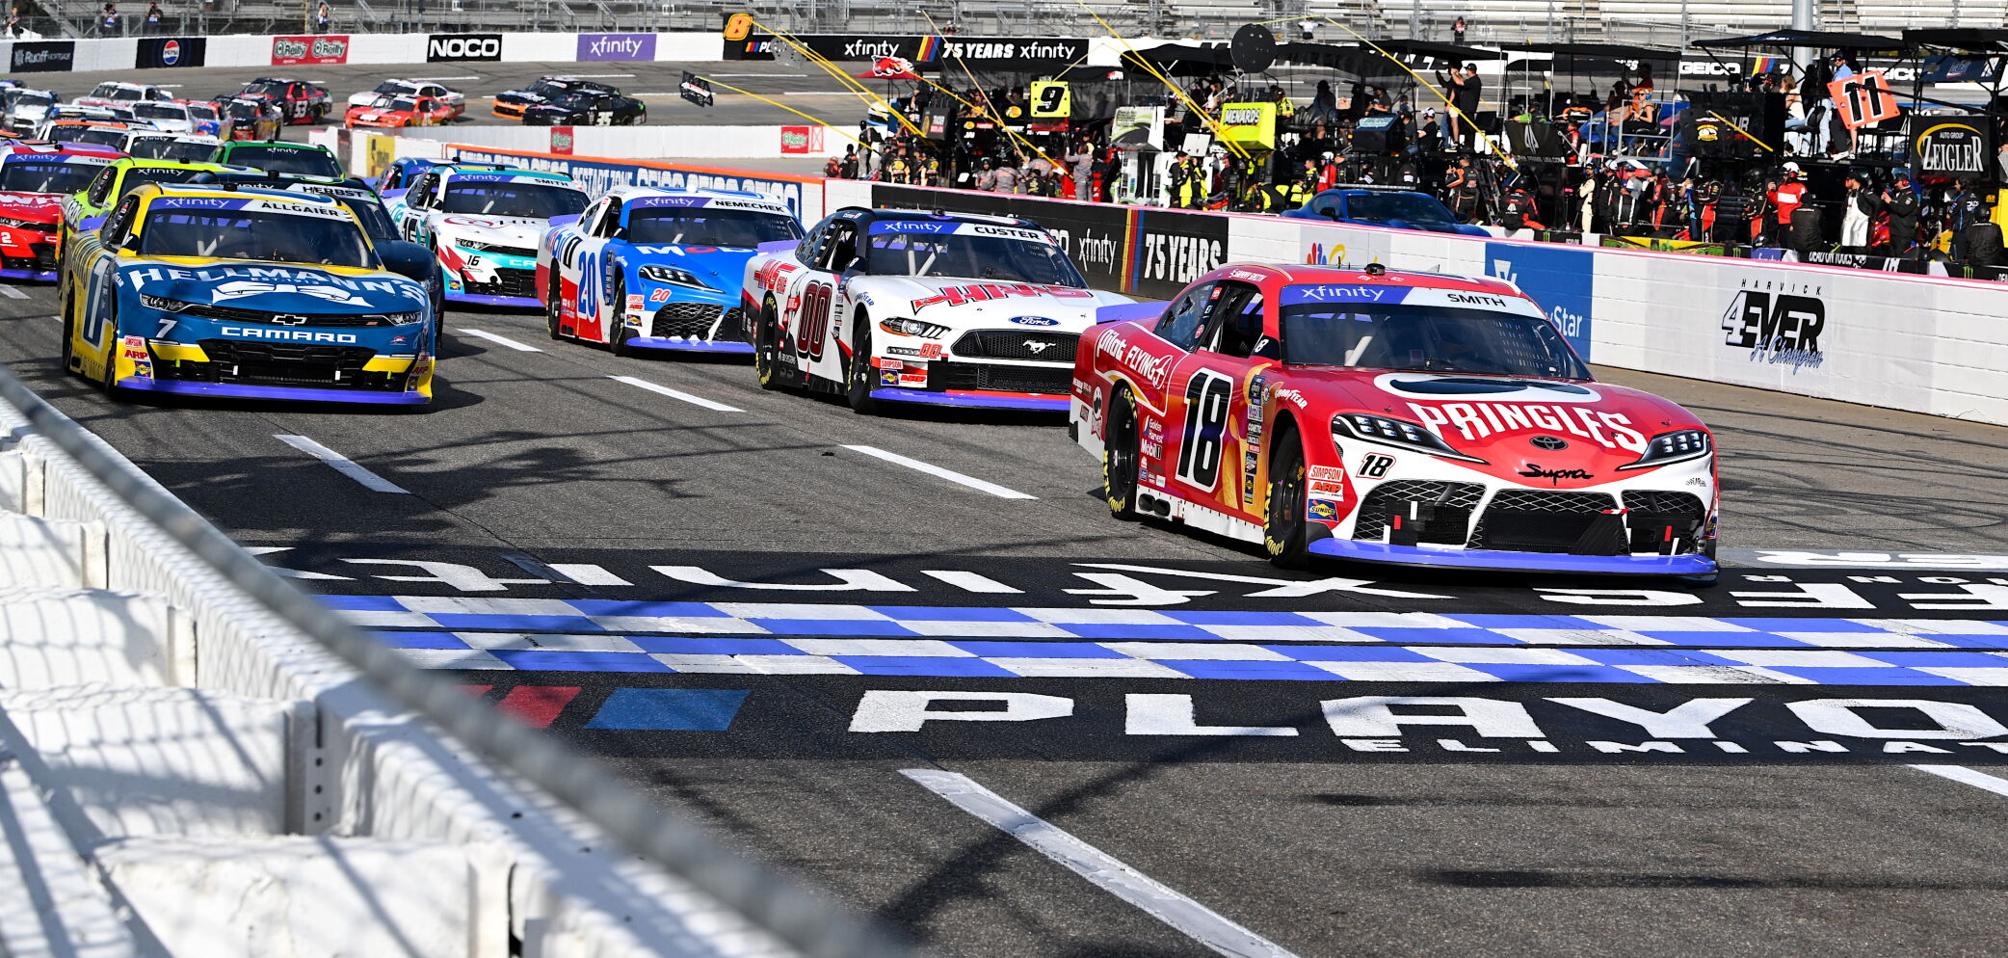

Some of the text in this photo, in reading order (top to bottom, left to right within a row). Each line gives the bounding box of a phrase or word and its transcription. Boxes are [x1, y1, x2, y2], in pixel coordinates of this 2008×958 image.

[723, 13, 753, 41] 8
[428, 39, 499, 58] NOCO
[590, 37, 643, 58] xfinity
[844, 39, 900, 57] xfinity
[942, 41, 1076, 59] 75 YEARS xfinity
[1679, 61, 1741, 75] GEICO
[1036, 86, 1065, 113] 9
[1843, 74, 1884, 126] 11
[1225, 108, 1260, 125] MENARDS
[15, 154, 58, 162] xfinity
[267, 147, 300, 155] xfinity
[1921, 130, 1984, 172] ZEIGLER
[137, 168, 185, 177] xfinity
[458, 174, 569, 187] xfinity SMITH
[302, 185, 364, 199] HERBST
[165, 197, 339, 217] xfinity ALLGAIER
[644, 197, 785, 213] xfinity NEMECHEK
[884, 222, 1041, 240] xfinity CUSTER
[467, 254, 482, 266] 16
[1078, 228, 1117, 275] xfinity
[1144, 234, 1222, 283] 75 YEARS
[128, 266, 427, 308] HELLMANN'S
[578, 250, 597, 318] 20
[1741, 278, 1822, 296] HARVICK
[649, 288, 672, 302] 20
[1301, 286, 1506, 308] xfinity SMITH
[797, 279, 833, 363] 00
[1020, 315, 1052, 327] Ford
[155, 318, 356, 344] 7 CAMARO
[124, 349, 148, 359] ARP
[1096, 329, 1128, 362] Pilot
[1124, 345, 1160, 381] FLYING
[1767, 334, 1824, 375] Champion
[1176, 369, 1234, 491] 18
[1406, 401, 1649, 454] PRINGLES
[1310, 466, 1342, 481] SIMPSON
[1358, 453, 1395, 478] 18
[1518, 463, 1594, 486] Supra
[1310, 481, 1342, 493] ARP
[1310, 506, 1336, 516] SUNOCO
[848, 689, 2008, 741] PLAYO
